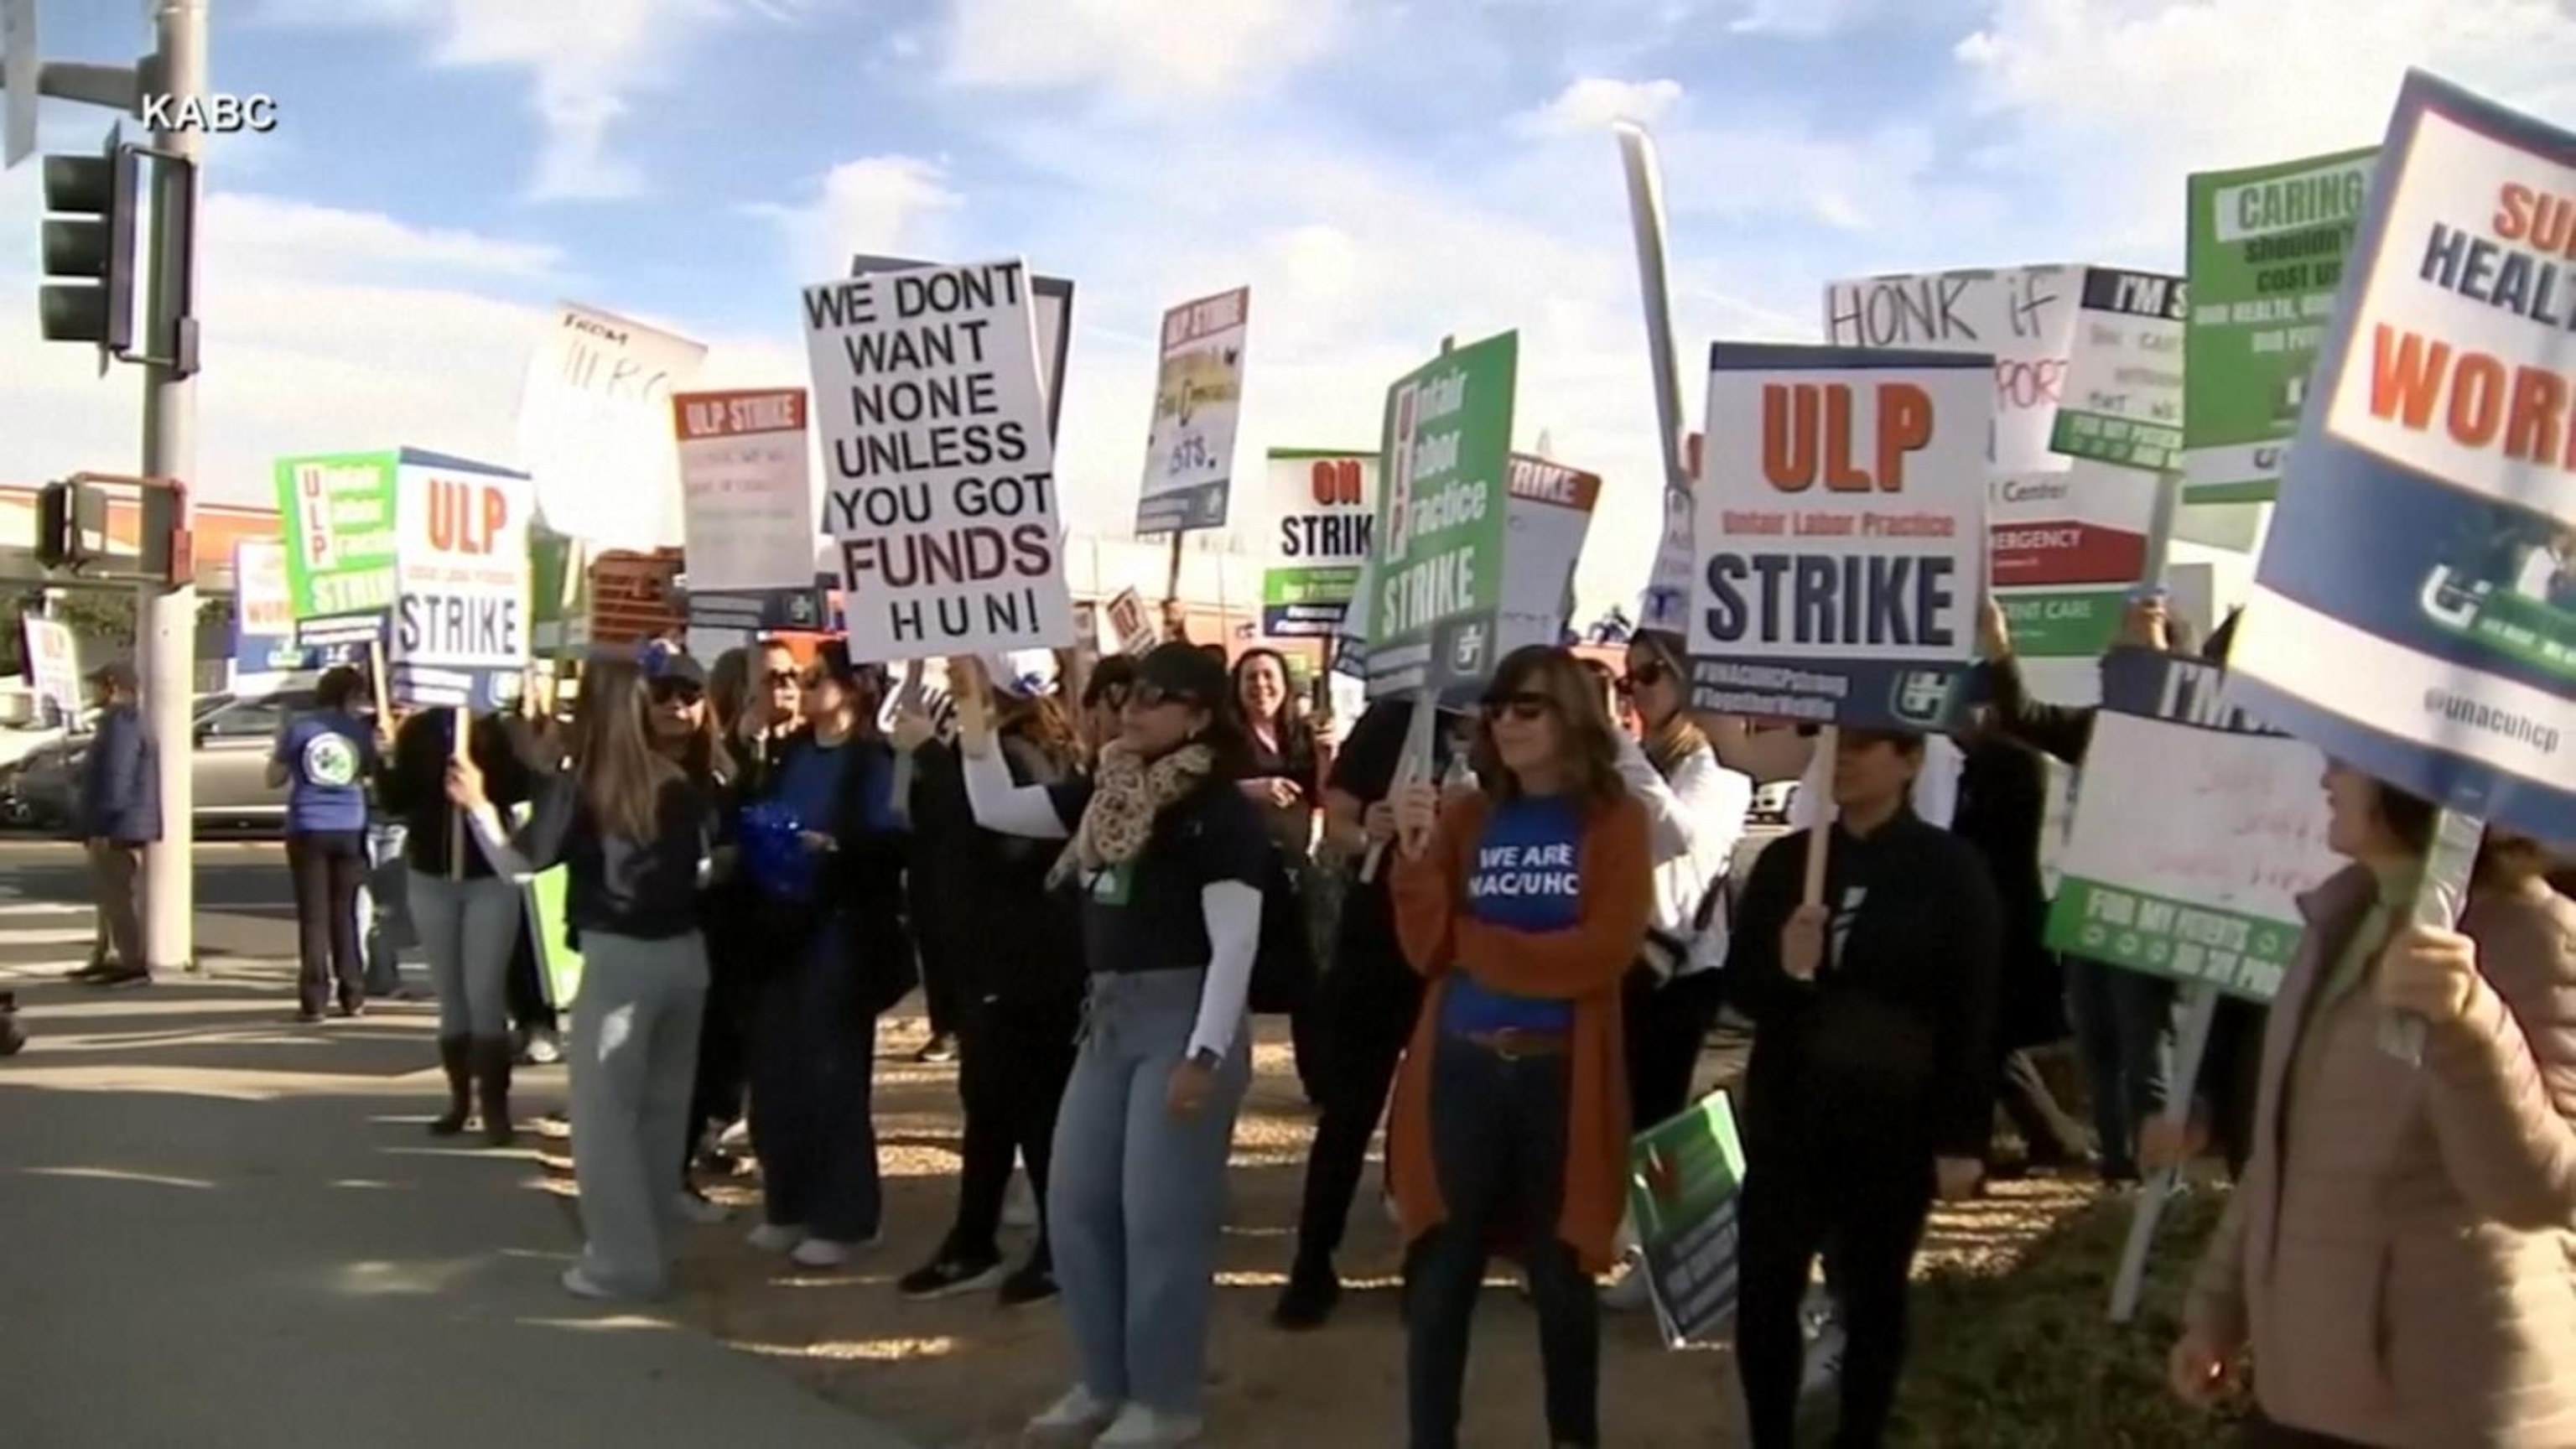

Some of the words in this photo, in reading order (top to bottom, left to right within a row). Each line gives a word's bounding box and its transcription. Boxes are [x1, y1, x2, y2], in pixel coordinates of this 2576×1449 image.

[2238, 170, 2363, 231] CARING
[2492, 181, 2576, 260] SU
[802, 283, 876, 330] WE
[895, 262, 1022, 318] DONT
[2419, 221, 2576, 332] HEAL
[1830, 277, 1978, 346] HONK
[844, 319, 989, 376] WANT
[852, 371, 999, 427] NONE
[2369, 321, 2576, 473] WOR
[835, 421, 1027, 479] UNLESS
[1763, 382, 1935, 494] ULP
[833, 481, 931, 530] YOU
[953, 471, 1052, 517] GOT
[1509, 461, 1579, 502] RIKE
[2003, 481, 2069, 502] Center
[428, 478, 508, 555] ULP
[1793, 512, 1855, 537] Labor
[1996, 528, 2083, 550] ERGENCY
[841, 522, 1052, 592] FUNDS
[398, 592, 517, 655] STRIKE
[1382, 545, 1476, 639] STRIKE
[1706, 553, 1955, 647] STRIKE
[2045, 600, 2093, 619] CARE
[2423, 686, 2560, 754] @unacuhcp
[1479, 846, 1519, 869] WE
[1521, 843, 1575, 867] ARE
